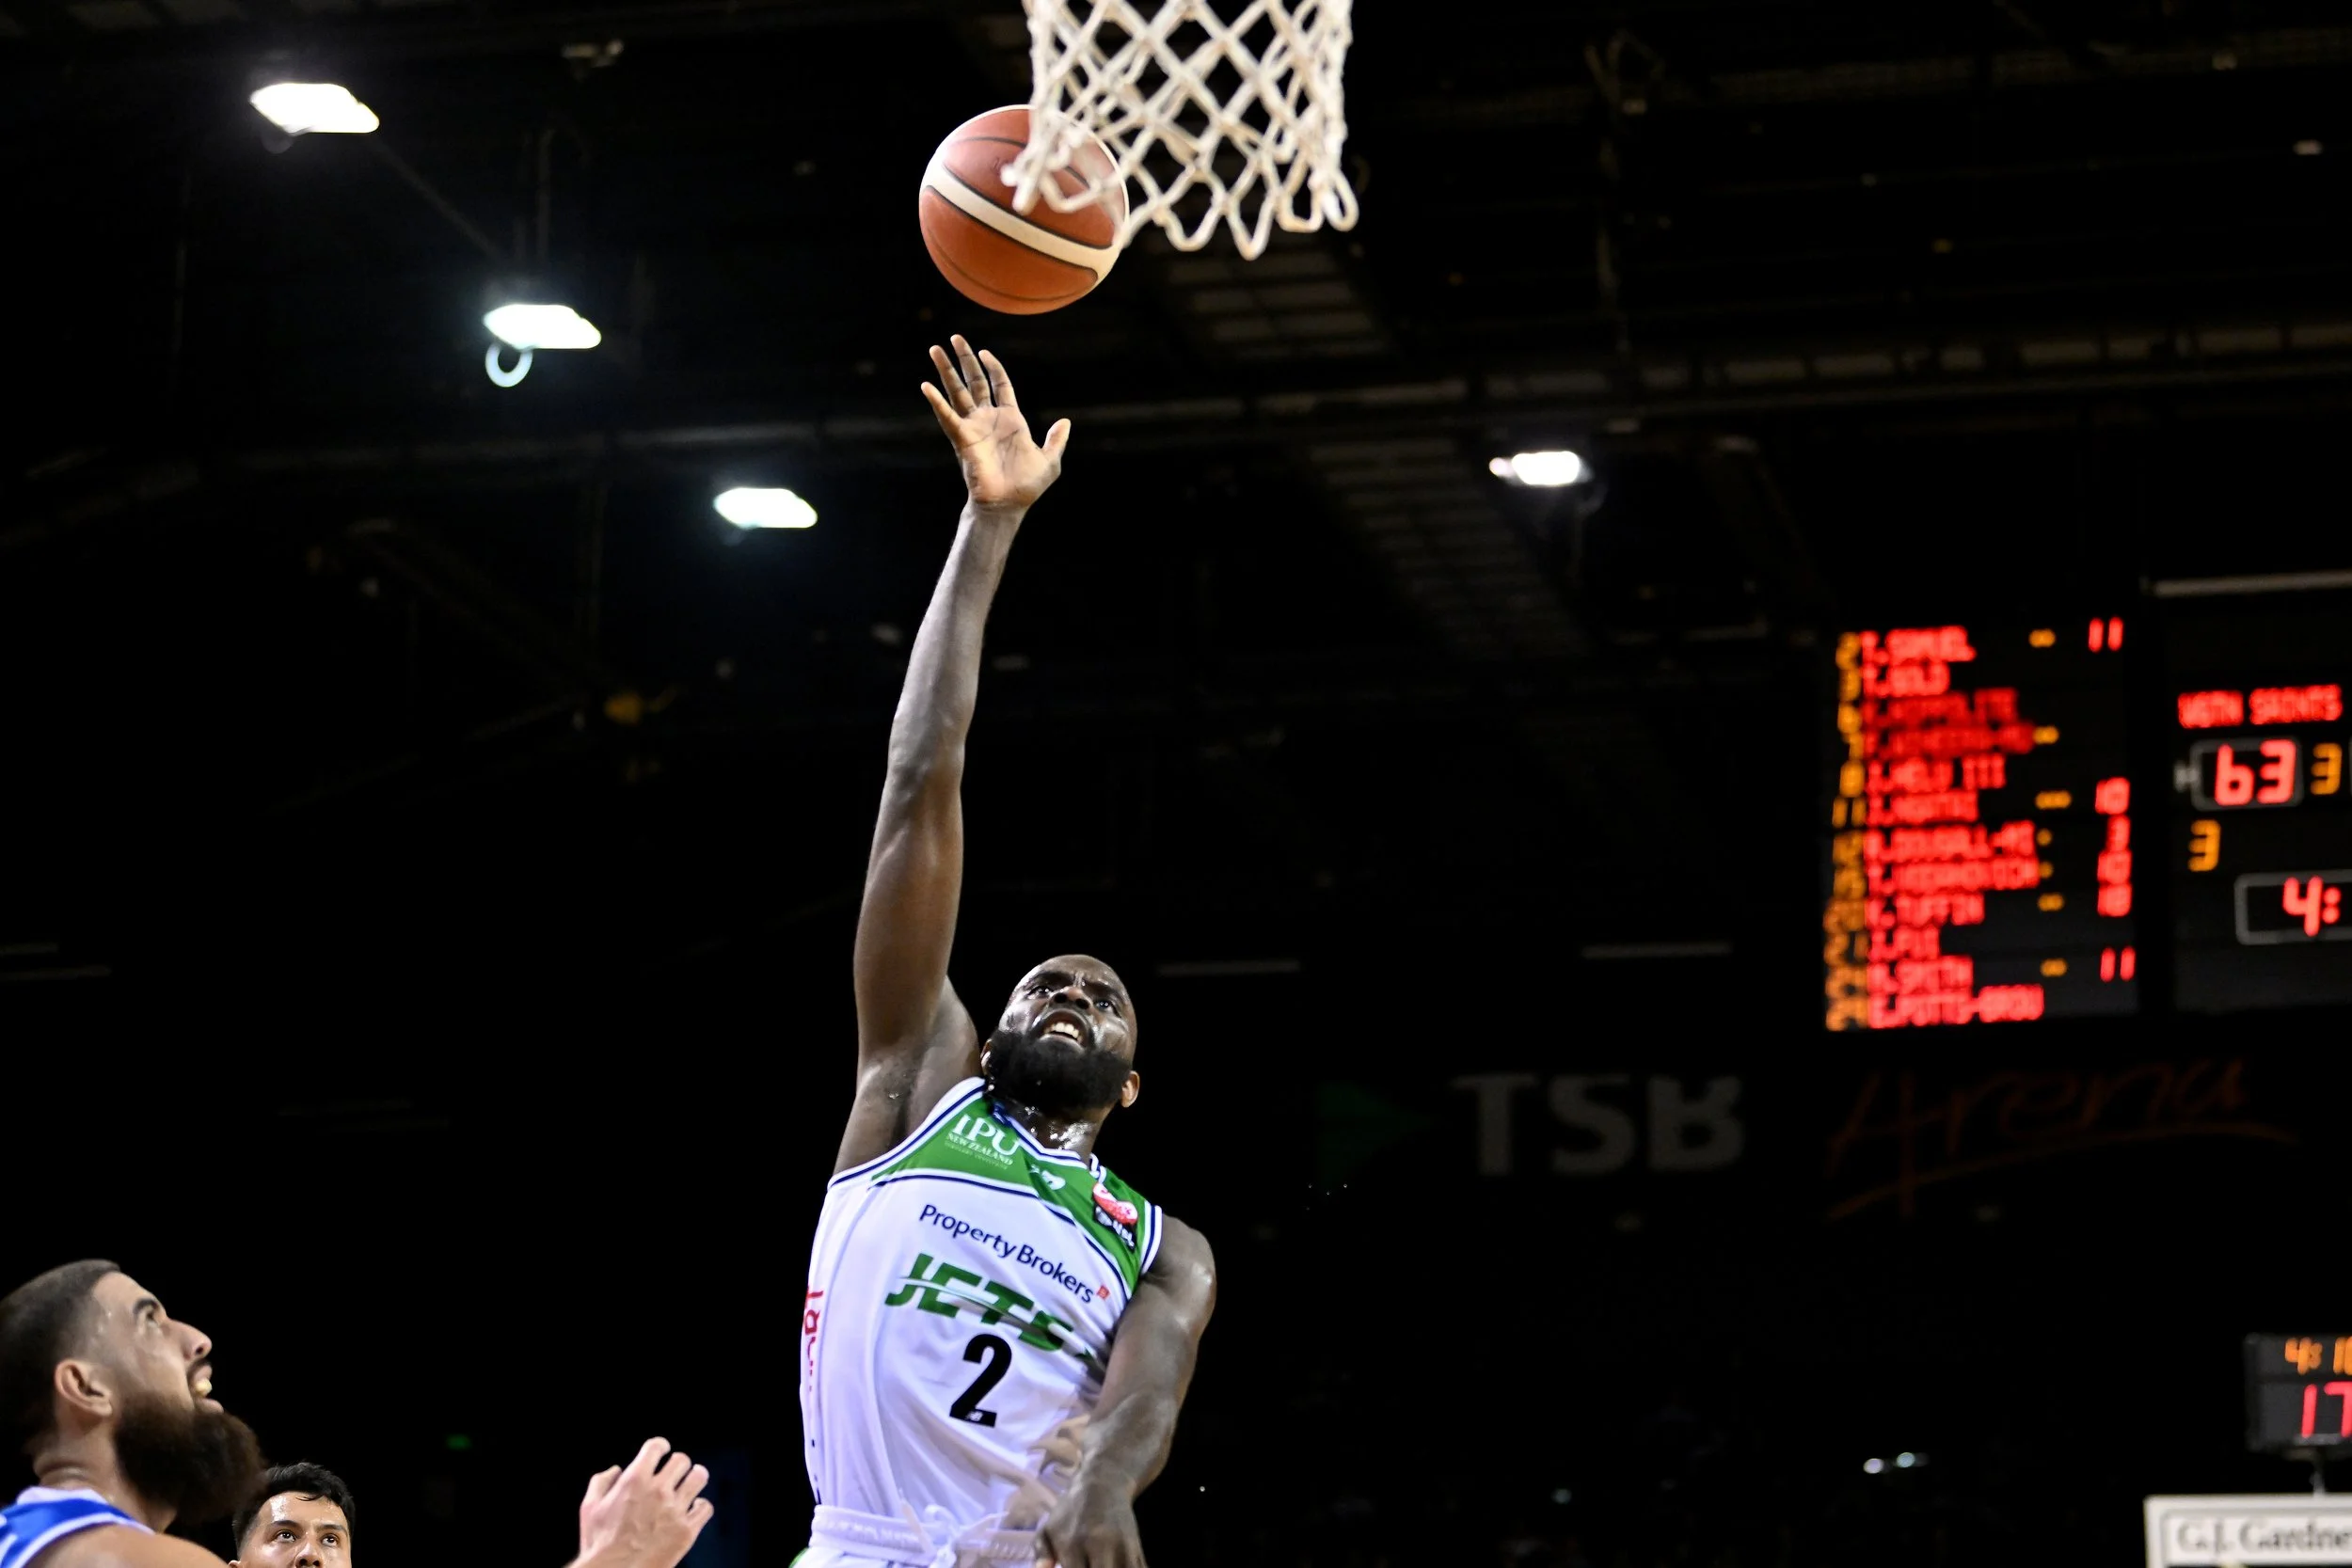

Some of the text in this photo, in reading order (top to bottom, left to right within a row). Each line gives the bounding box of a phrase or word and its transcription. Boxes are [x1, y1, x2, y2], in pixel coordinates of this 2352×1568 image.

[2215, 739, 2296, 806] 63
[2311, 743, 2343, 796] 3
[2187, 819, 2221, 872] 3
[952, 1114, 1020, 1156] IPU
[918, 1204, 1095, 1304] Property Brokers
[948, 1333, 1012, 1428] 2
[2301, 1381, 2352, 1438] 17
